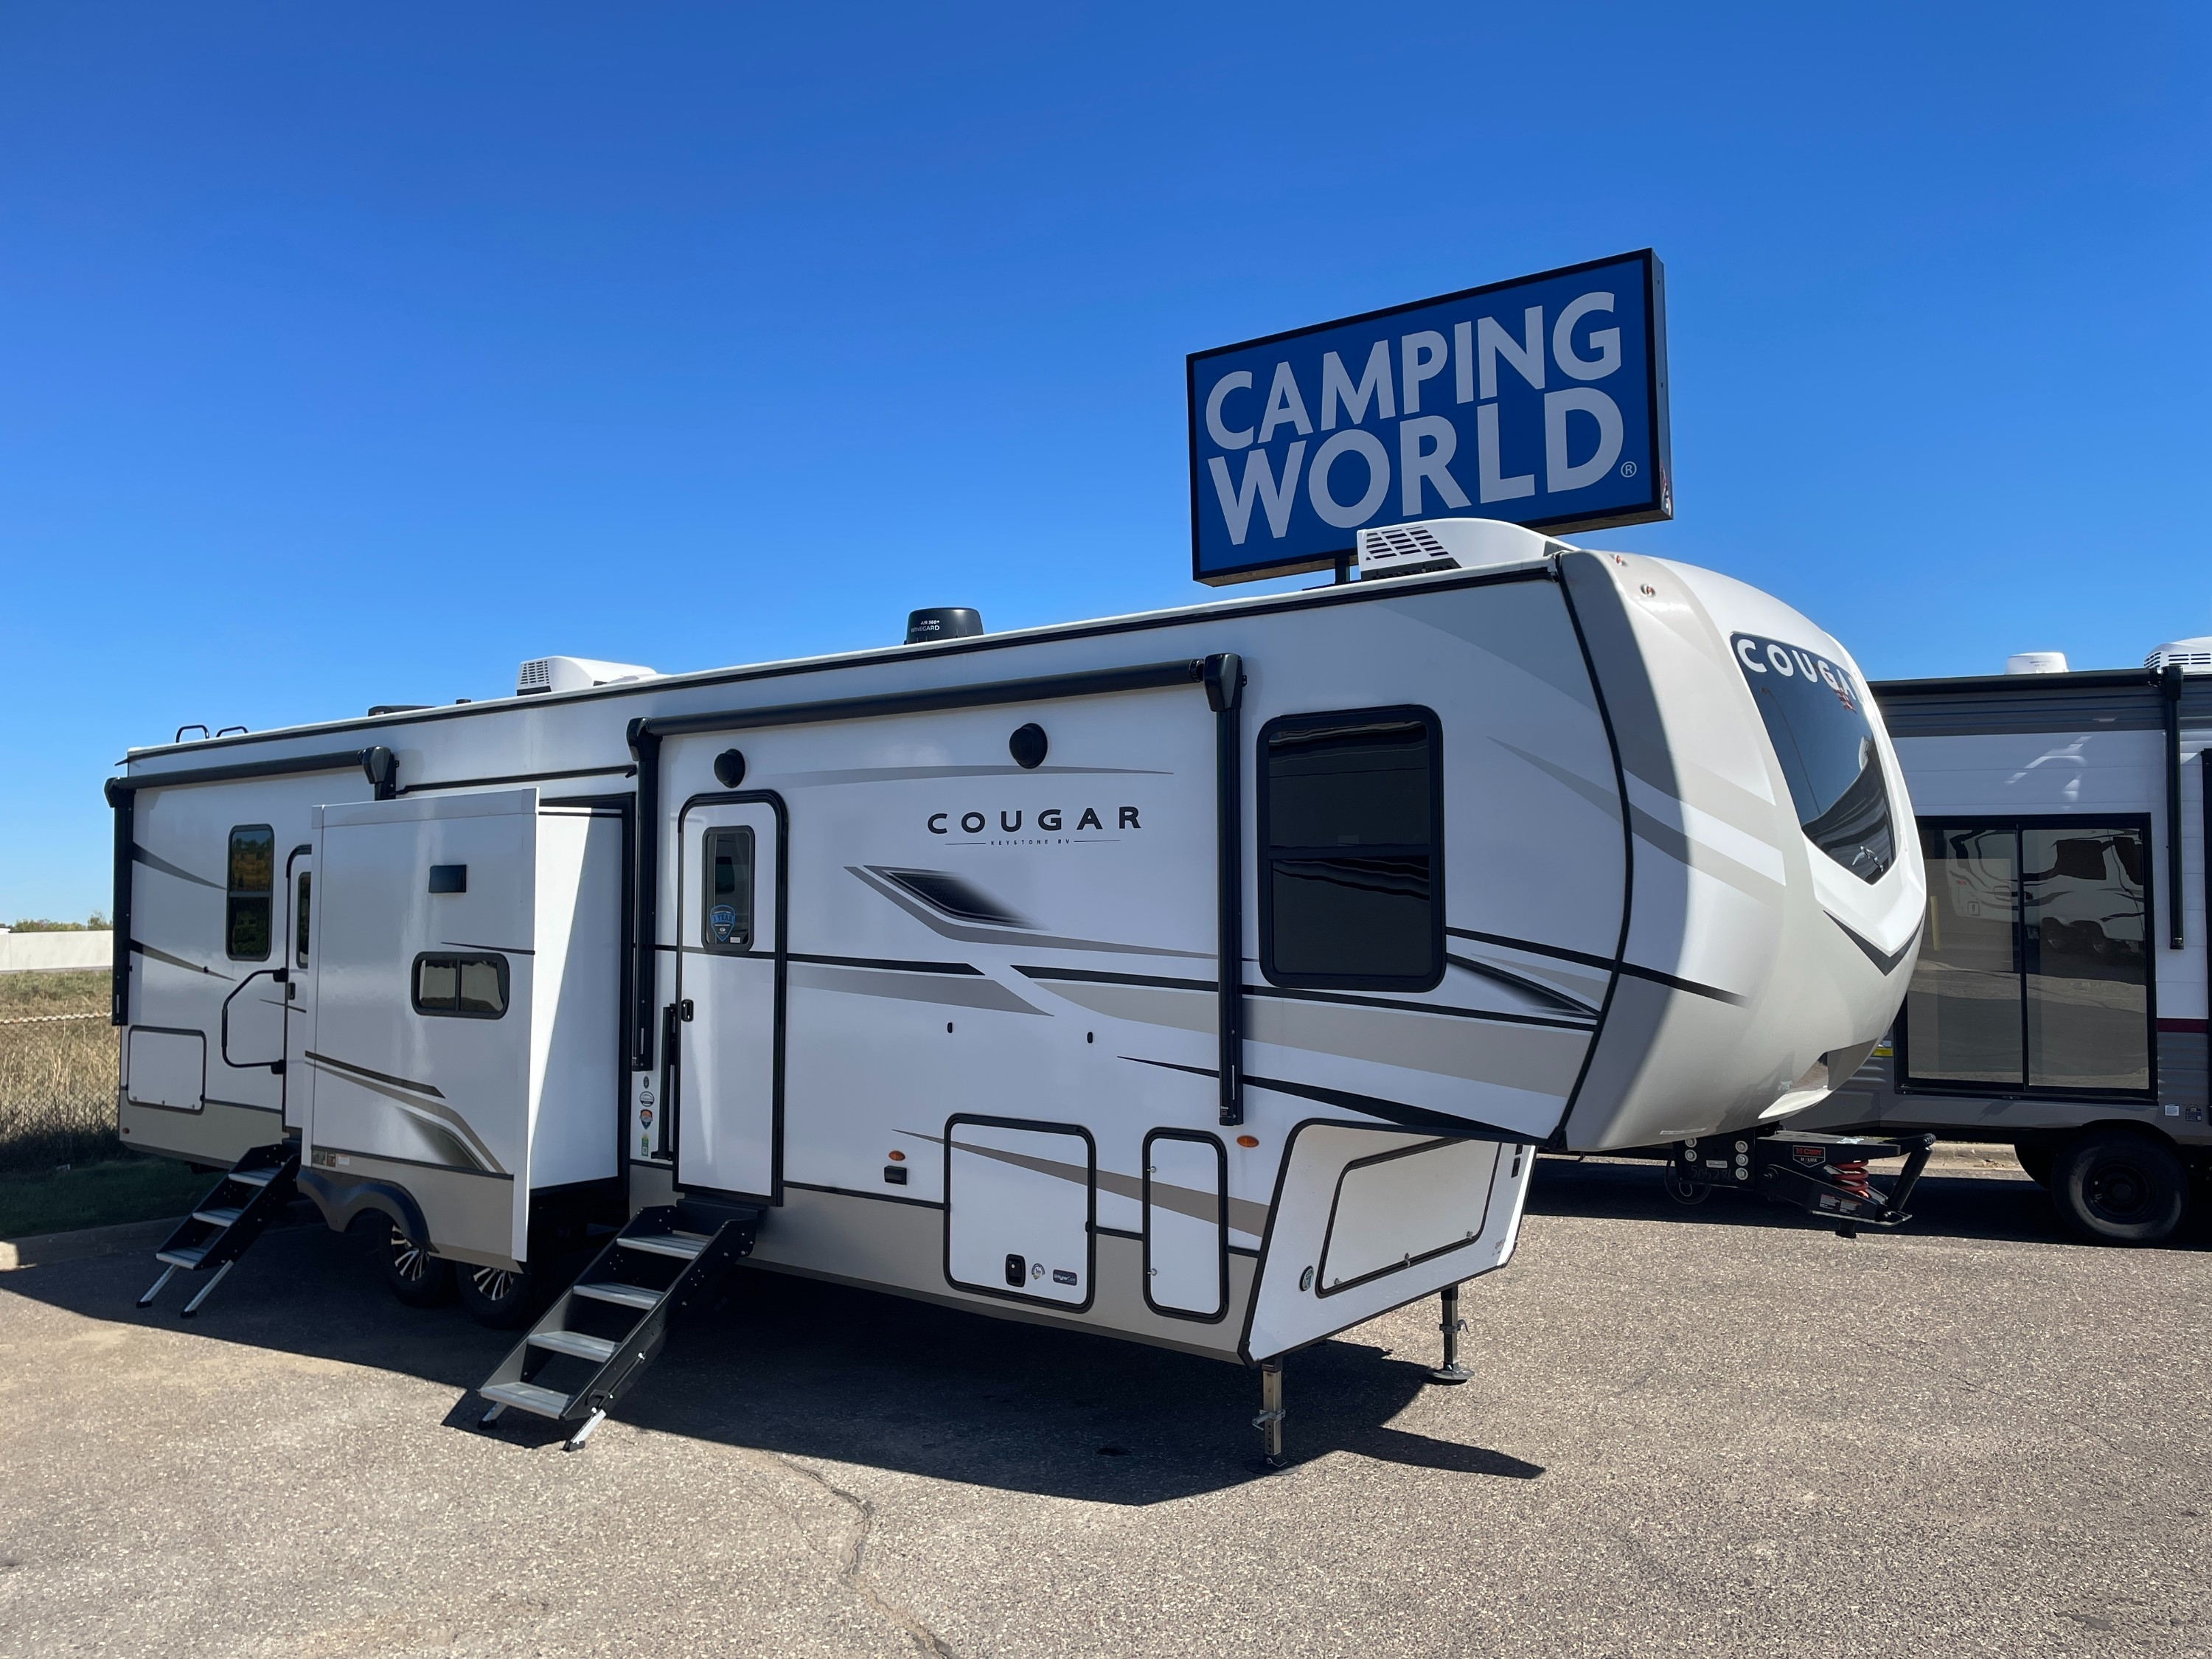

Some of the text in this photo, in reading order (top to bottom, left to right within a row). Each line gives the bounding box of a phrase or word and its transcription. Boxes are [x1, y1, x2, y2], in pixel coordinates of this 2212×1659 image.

[1206, 291, 1621, 450] CAMPING
[1207, 387, 1624, 546] WORLD
[1736, 639, 1864, 705] COUGA
[927, 806, 1141, 835] COUGAR
